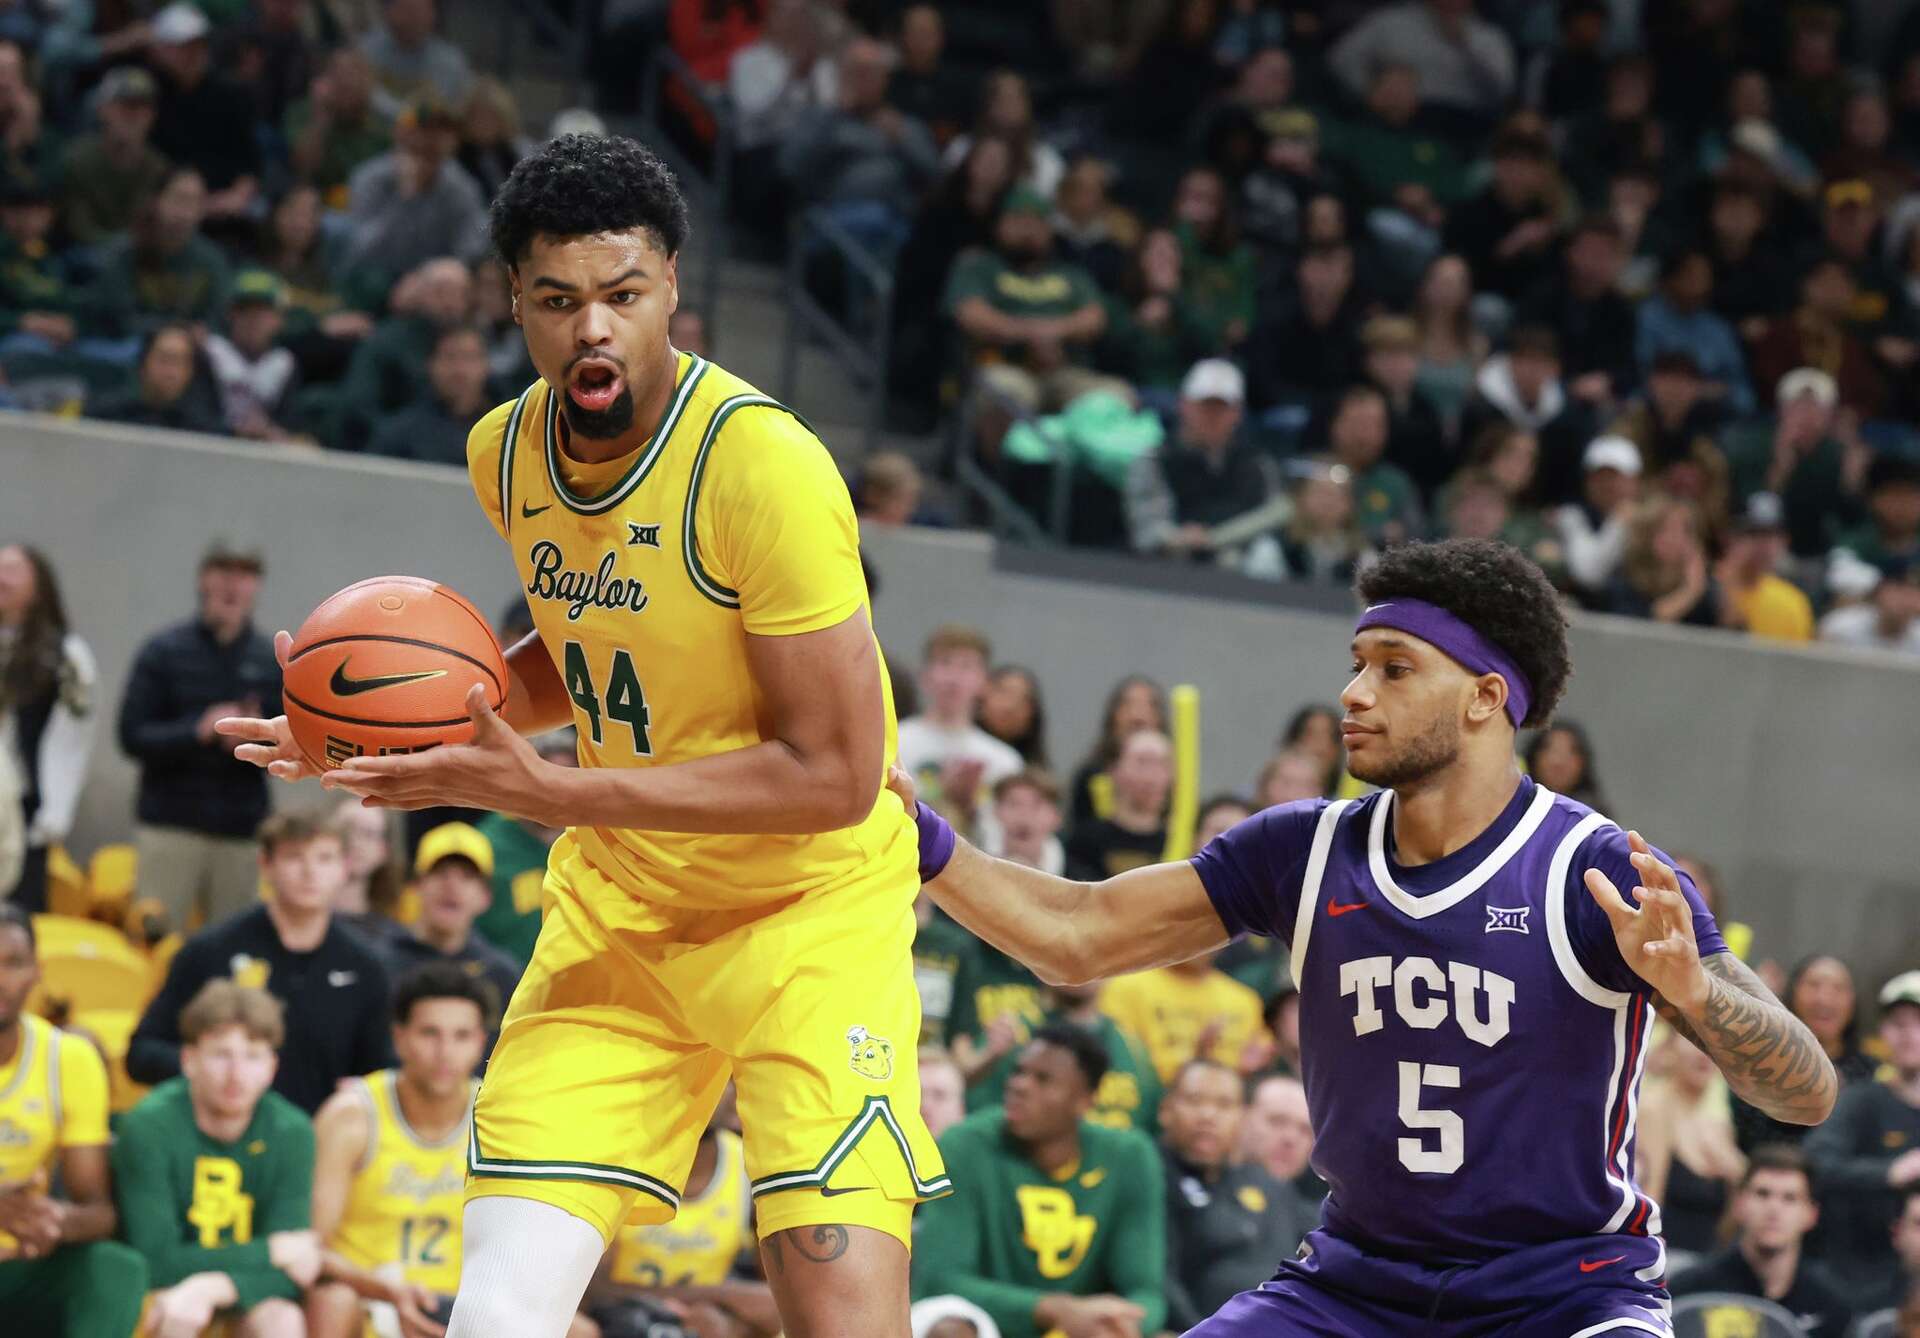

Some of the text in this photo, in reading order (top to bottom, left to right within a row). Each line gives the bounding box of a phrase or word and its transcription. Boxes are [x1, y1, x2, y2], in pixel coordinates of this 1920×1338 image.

[528, 541, 647, 620] Baylor
[564, 640, 652, 755] 44
[1339, 955, 1516, 1048] TCU
[1397, 1060, 1464, 1174] 5
[400, 1216, 451, 1263] 12
